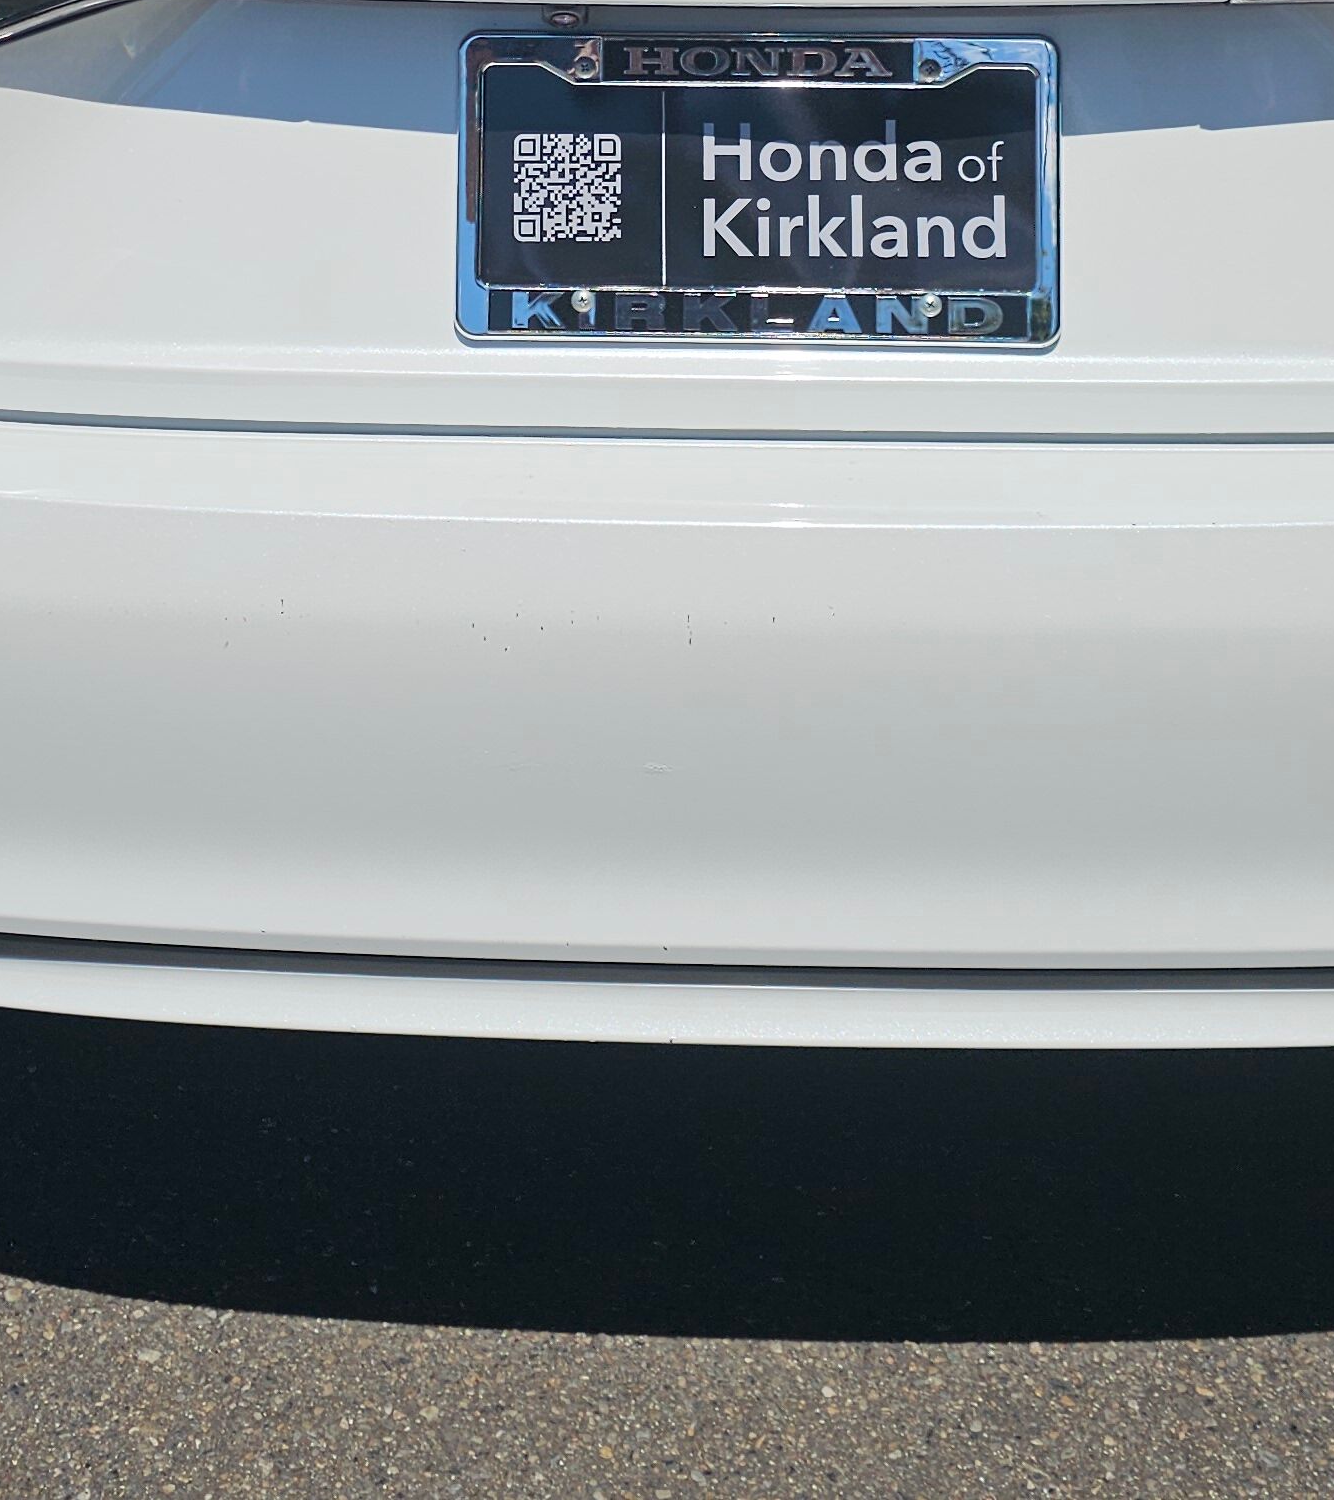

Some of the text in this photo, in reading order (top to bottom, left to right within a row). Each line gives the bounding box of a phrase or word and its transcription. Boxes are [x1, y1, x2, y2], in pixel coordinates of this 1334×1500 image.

[623, 47, 893, 77] HONDA
[702, 119, 1005, 182] Honda of
[702, 194, 1008, 259] Kirkland
